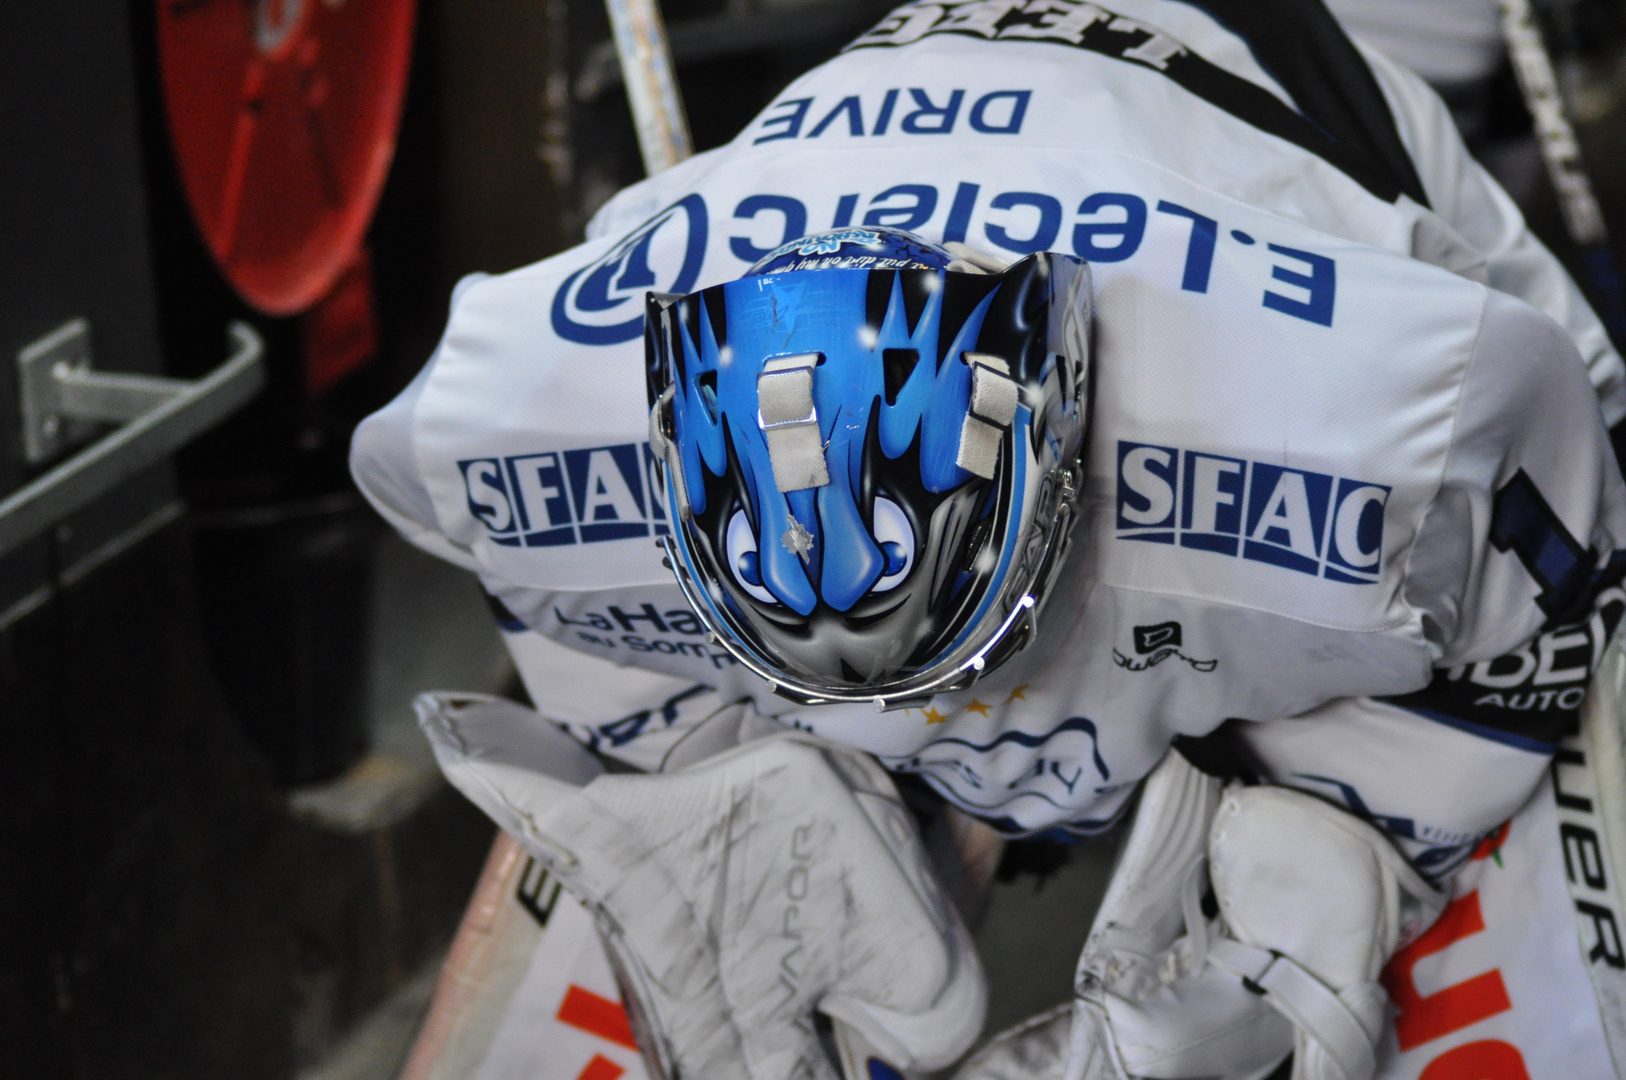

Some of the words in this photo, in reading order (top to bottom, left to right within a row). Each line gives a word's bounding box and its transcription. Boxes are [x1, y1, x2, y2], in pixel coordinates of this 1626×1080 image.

[752, 88, 1034, 147] DRIVE
[797, 238, 841, 257] NO
[821, 255, 843, 267] on
[845, 255, 877, 269] dirt
[878, 256, 911, 269] put
[1120, 446, 1387, 568] SFAC
[1473, 686, 1586, 712] AUTO
[768, 819, 813, 1019] VAPOR
